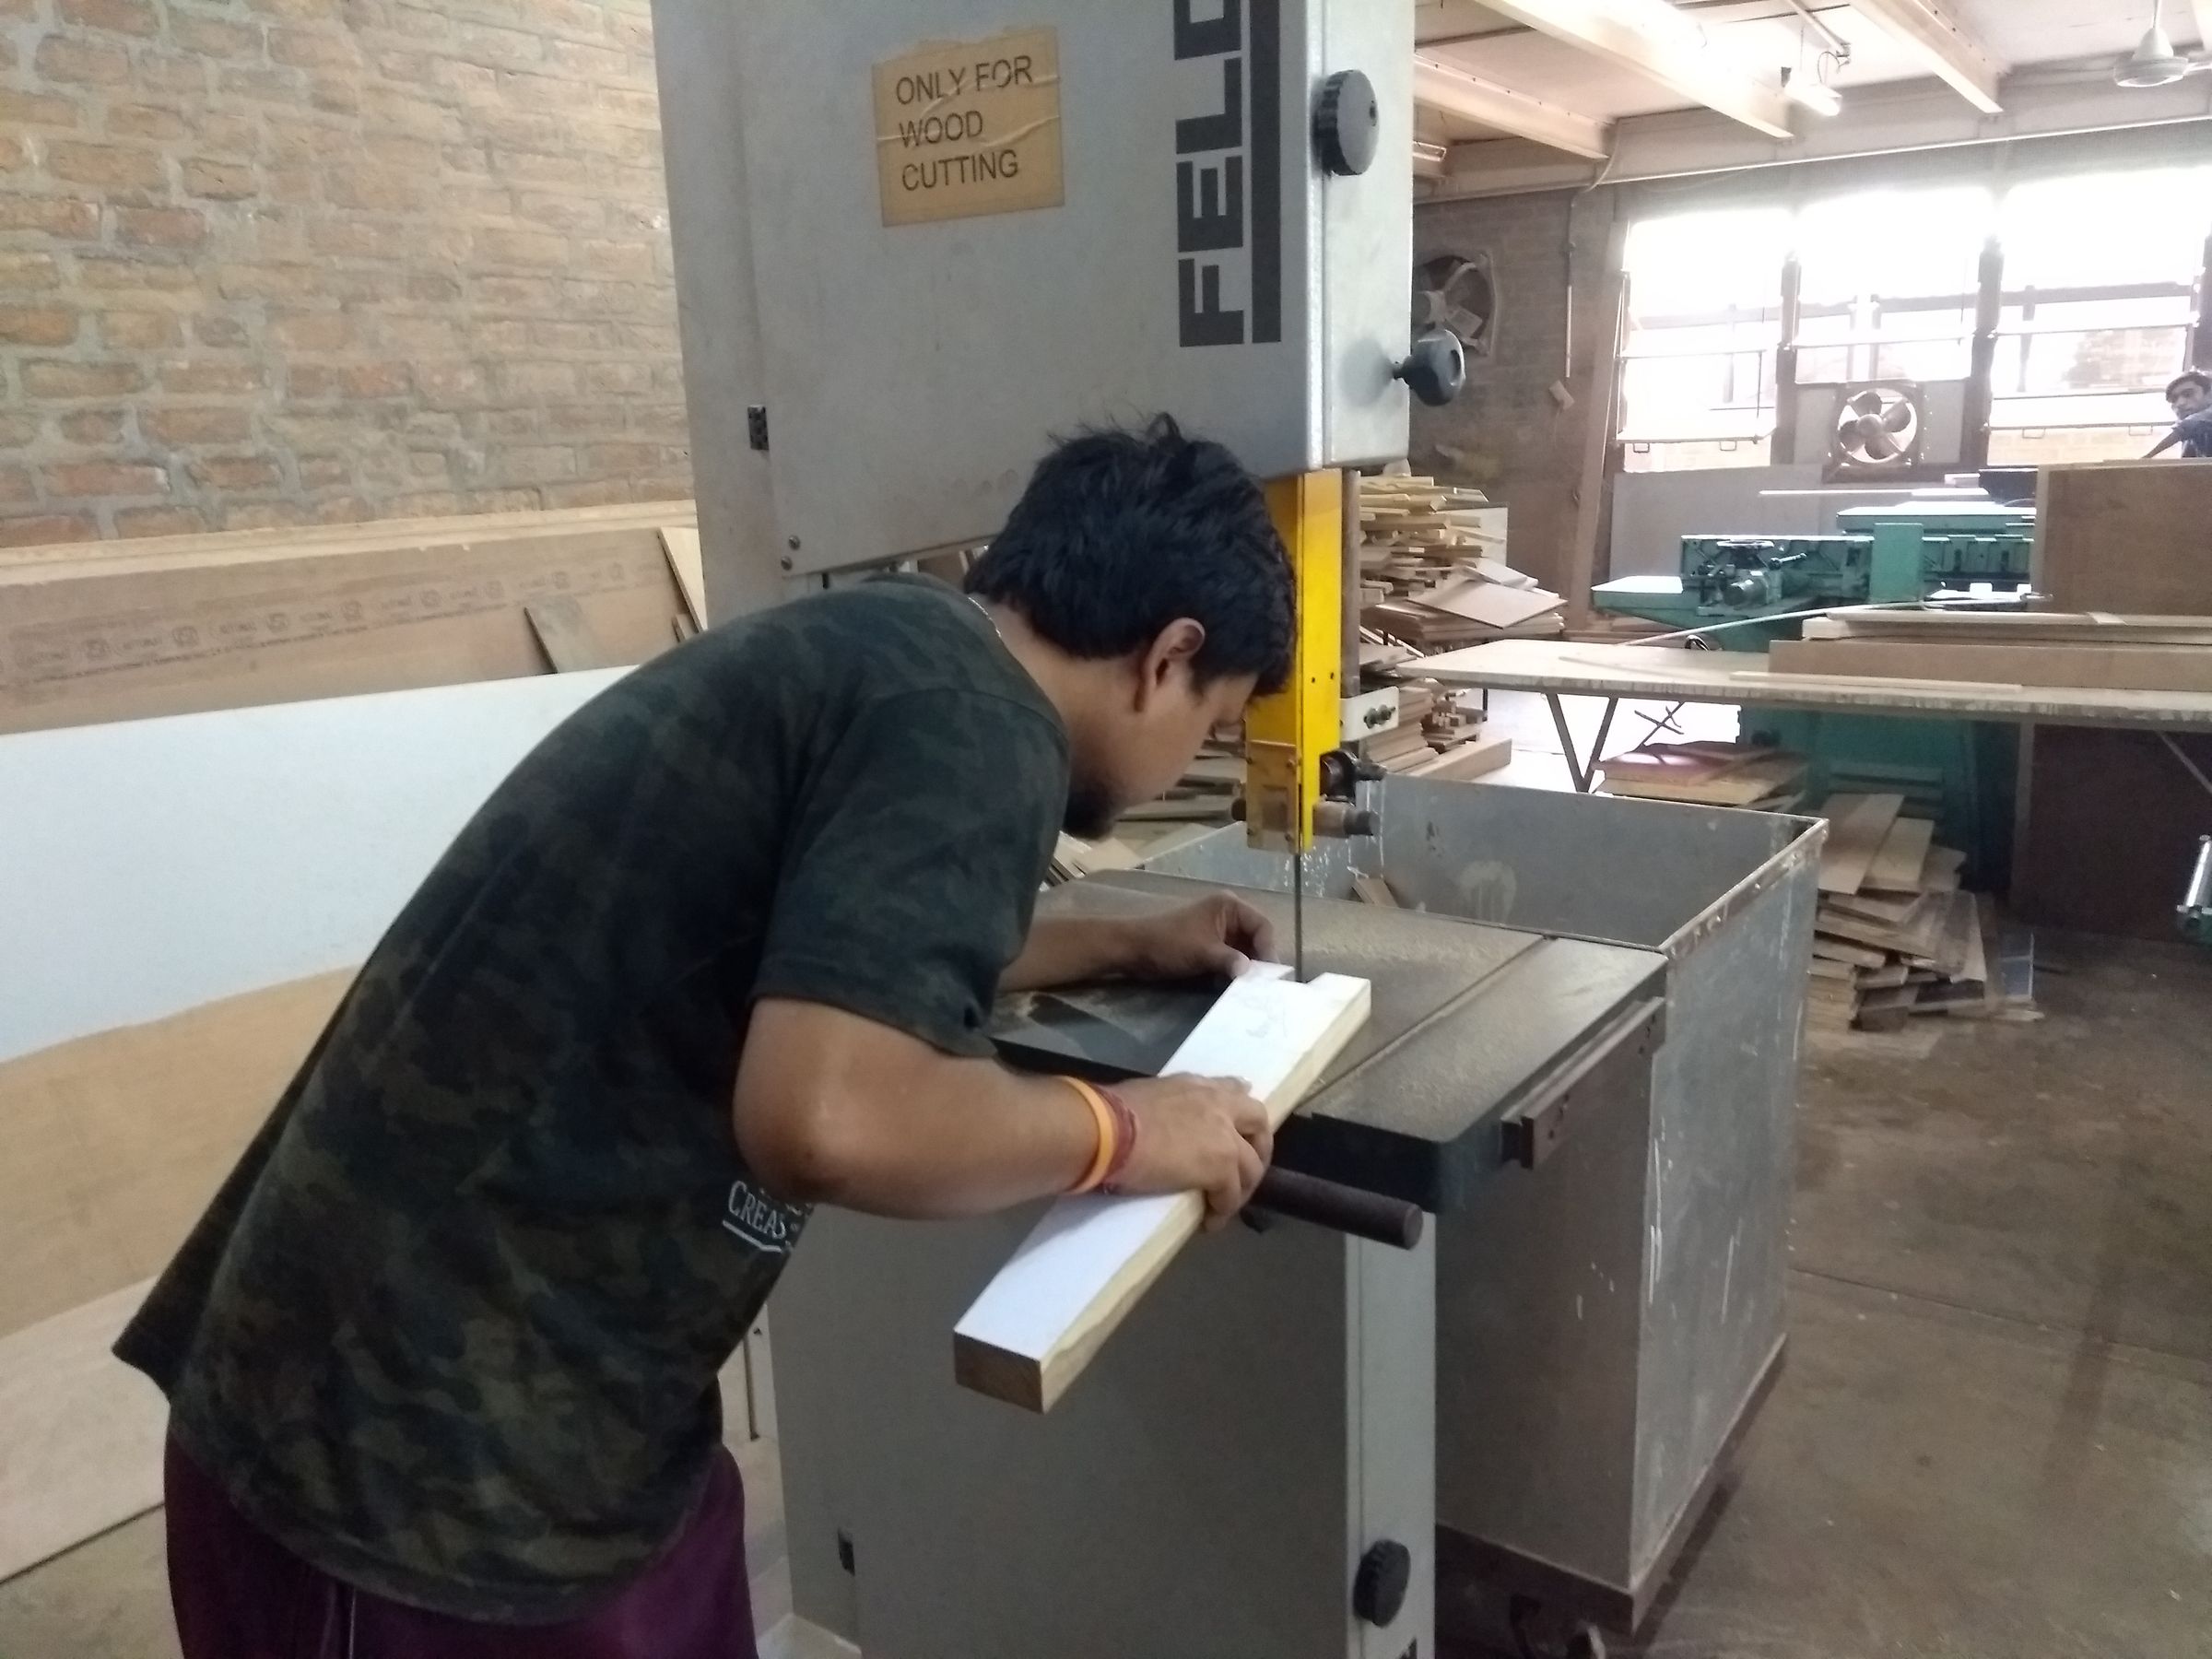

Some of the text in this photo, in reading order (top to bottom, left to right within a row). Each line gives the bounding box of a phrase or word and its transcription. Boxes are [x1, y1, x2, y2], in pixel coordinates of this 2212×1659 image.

[896, 55, 1033, 105] ONLY FOR
[899, 111, 983, 148] WOOD
[901, 149, 1018, 191] CUTTING
